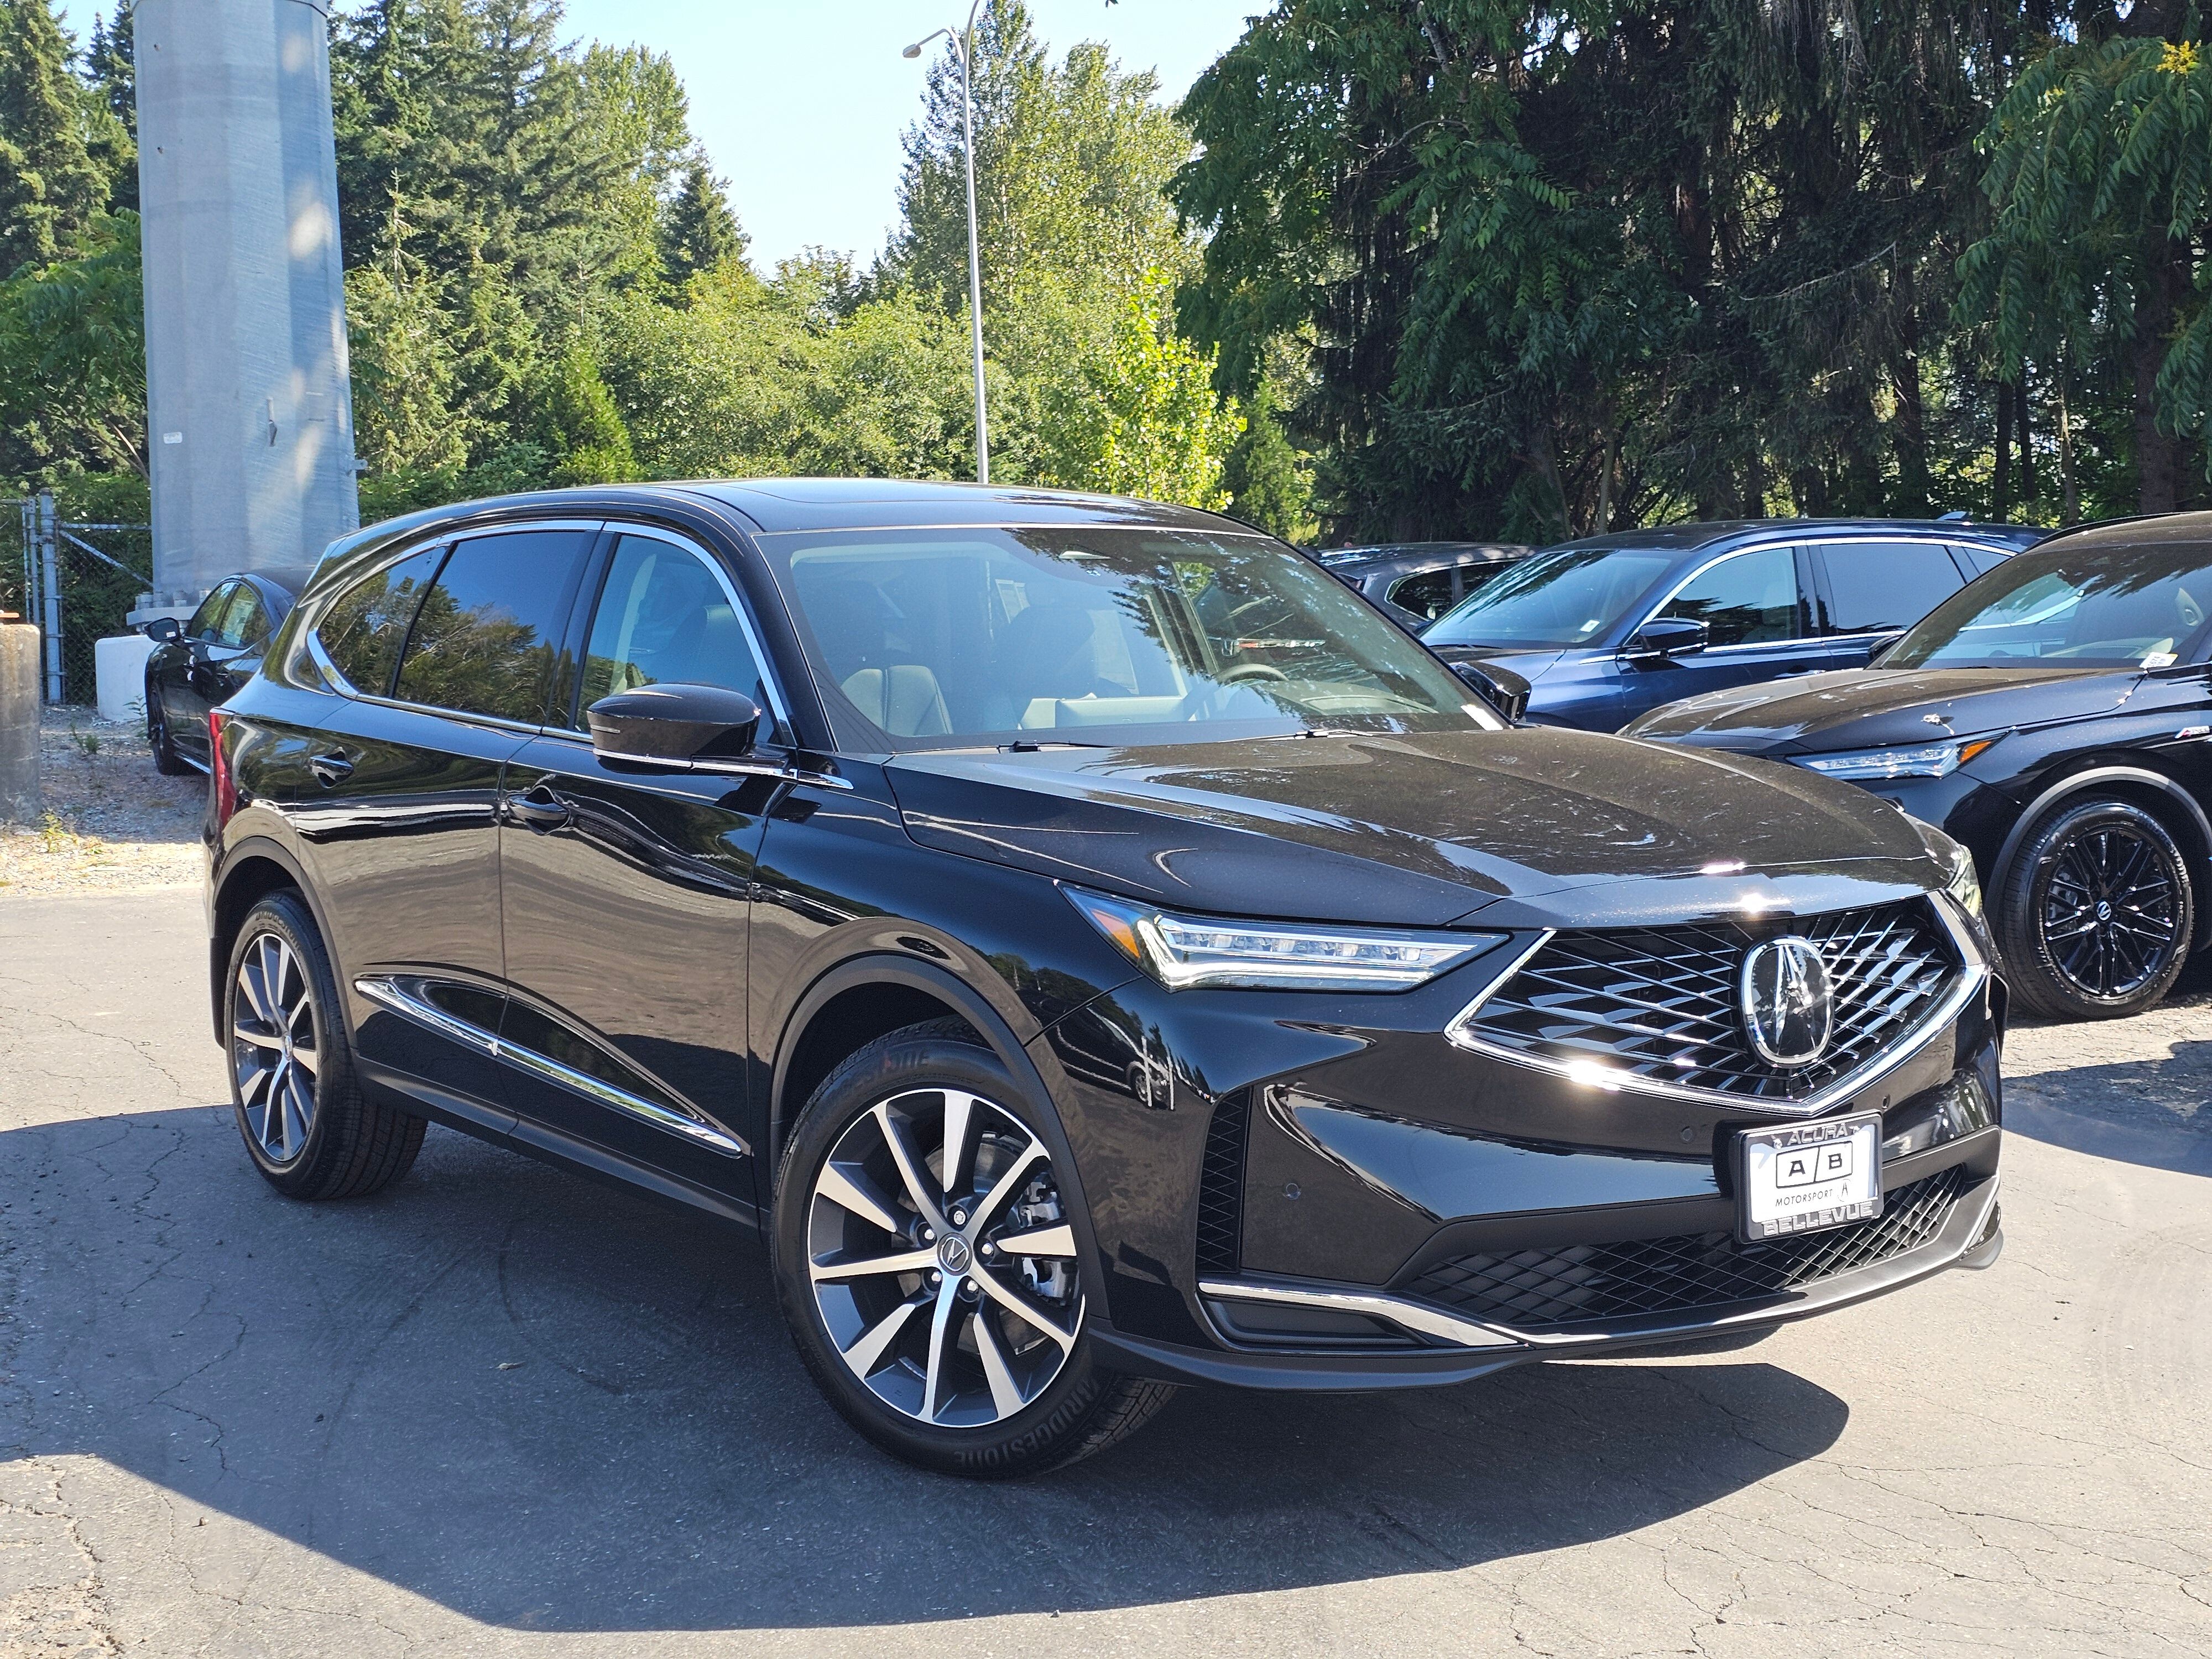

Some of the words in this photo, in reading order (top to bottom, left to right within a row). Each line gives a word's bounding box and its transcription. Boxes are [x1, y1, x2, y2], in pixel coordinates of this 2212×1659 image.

[1787, 1123, 1848, 1146] ACURA
[1788, 1160, 1806, 1177] A
[1828, 1153, 1843, 1170] B
[1776, 1189, 1833, 1207] MOTORSPORT
[1761, 1202, 1873, 1236] BELLEVUE
